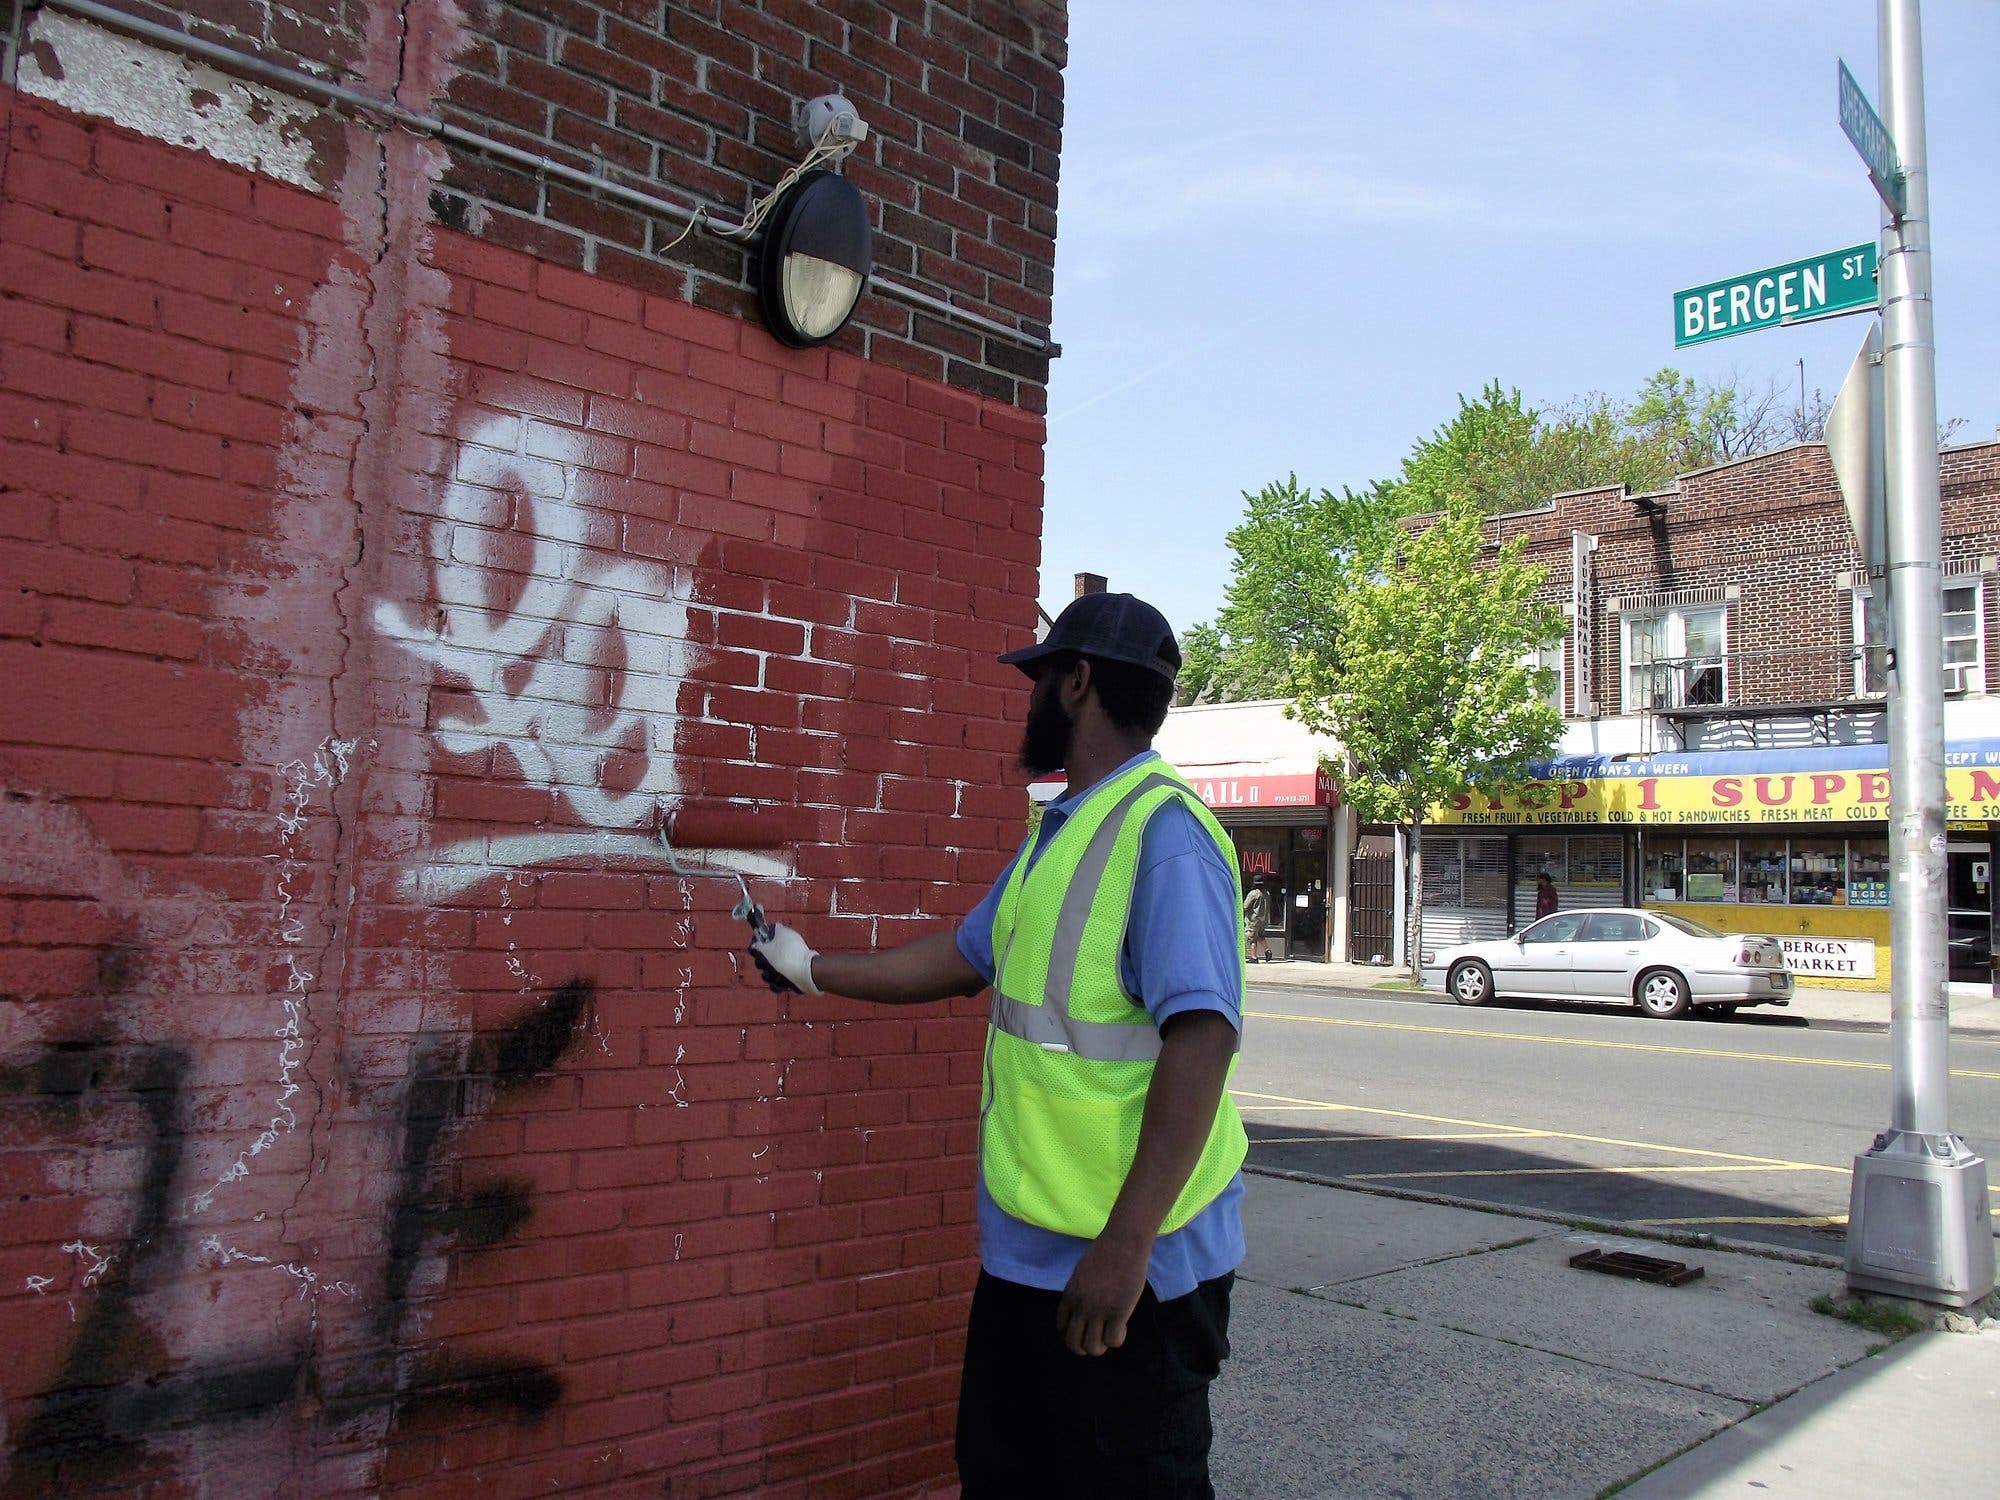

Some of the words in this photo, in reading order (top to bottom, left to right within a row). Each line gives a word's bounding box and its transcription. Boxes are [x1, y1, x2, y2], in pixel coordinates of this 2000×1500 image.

[1683, 264, 1827, 338] BERGEN
[1841, 253, 1865, 281] ST
[1945, 752, 1977, 765] CEPT
[1548, 767, 1580, 778] OPEN
[1599, 765, 1631, 776] DAYS
[1637, 764, 1647, 775] A
[1653, 763, 1689, 775] WEEK
[1637, 778, 1659, 810] 1
[1711, 770, 2000, 807] SUPEM
[1462, 812, 1491, 823] FRESH
[1495, 812, 1521, 823] FRUIT
[1526, 812, 1533, 823] &
[1538, 811, 1599, 823] VEGETABLES
[1608, 811, 1633, 822] COLD
[1639, 811, 1647, 822] &
[1652, 811, 1672, 822] HOT
[1678, 810, 1751, 822] SANDWICHES
[1761, 808, 1798, 821] FRESH
[1804, 807, 1833, 820] MEAT
[1846, 806, 1877, 819] COLD
[1242, 851, 1277, 874] NAIL
[1783, 941, 1848, 954] BERGEN
[1786, 958, 1857, 972] MARKET
